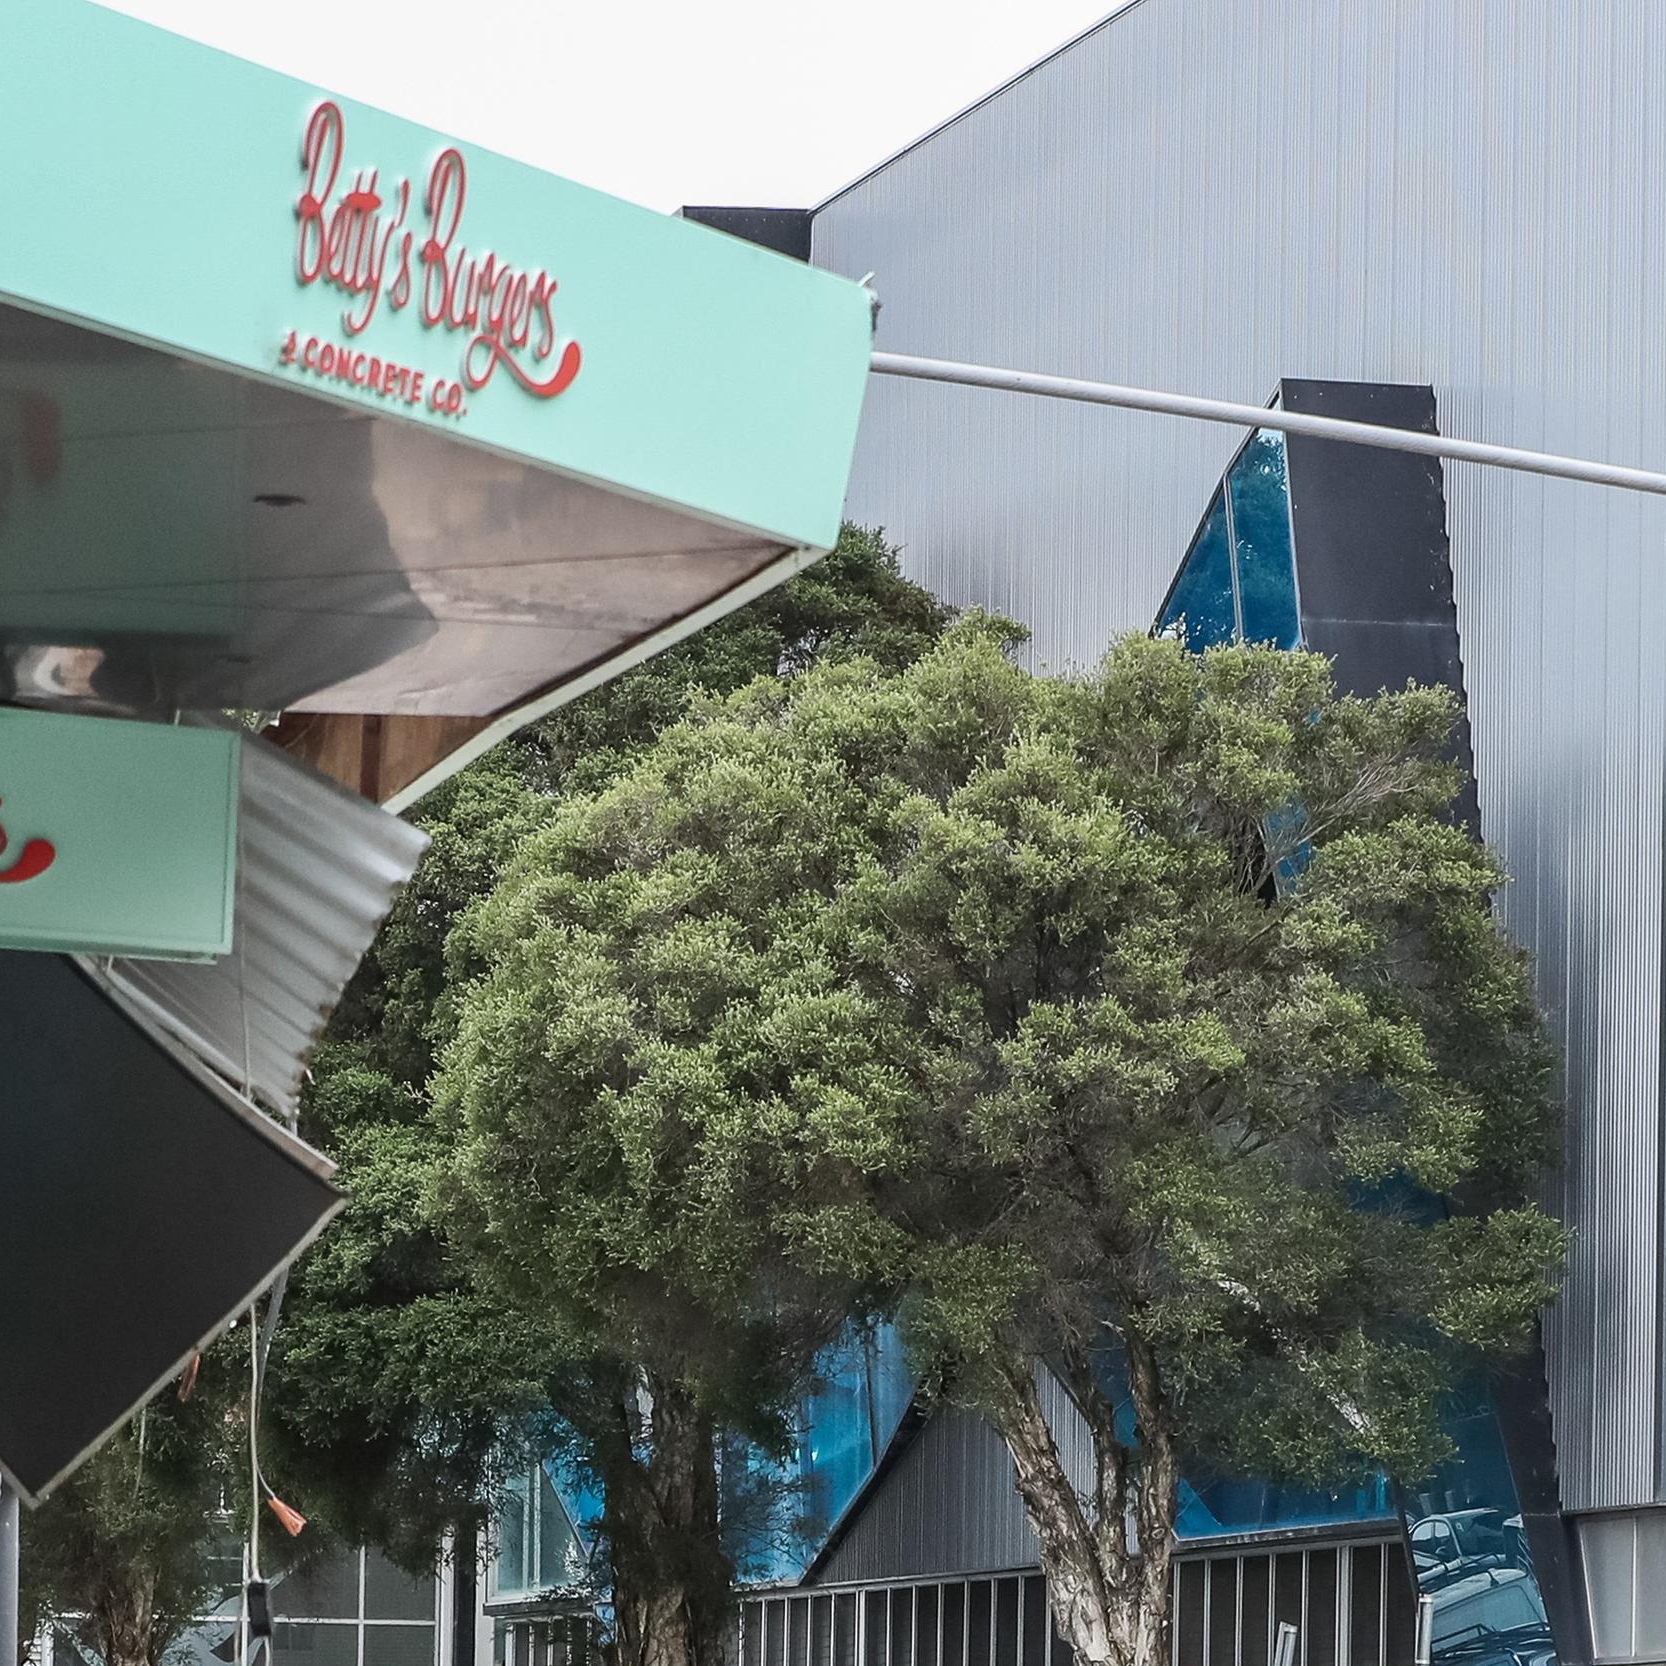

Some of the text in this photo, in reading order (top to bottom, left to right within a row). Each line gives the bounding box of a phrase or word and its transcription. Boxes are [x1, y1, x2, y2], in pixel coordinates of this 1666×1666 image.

[296, 100, 583, 399] Betty's Burgers
[303, 336, 425, 403] CONCRETE
[430, 378, 469, 417] CO.
